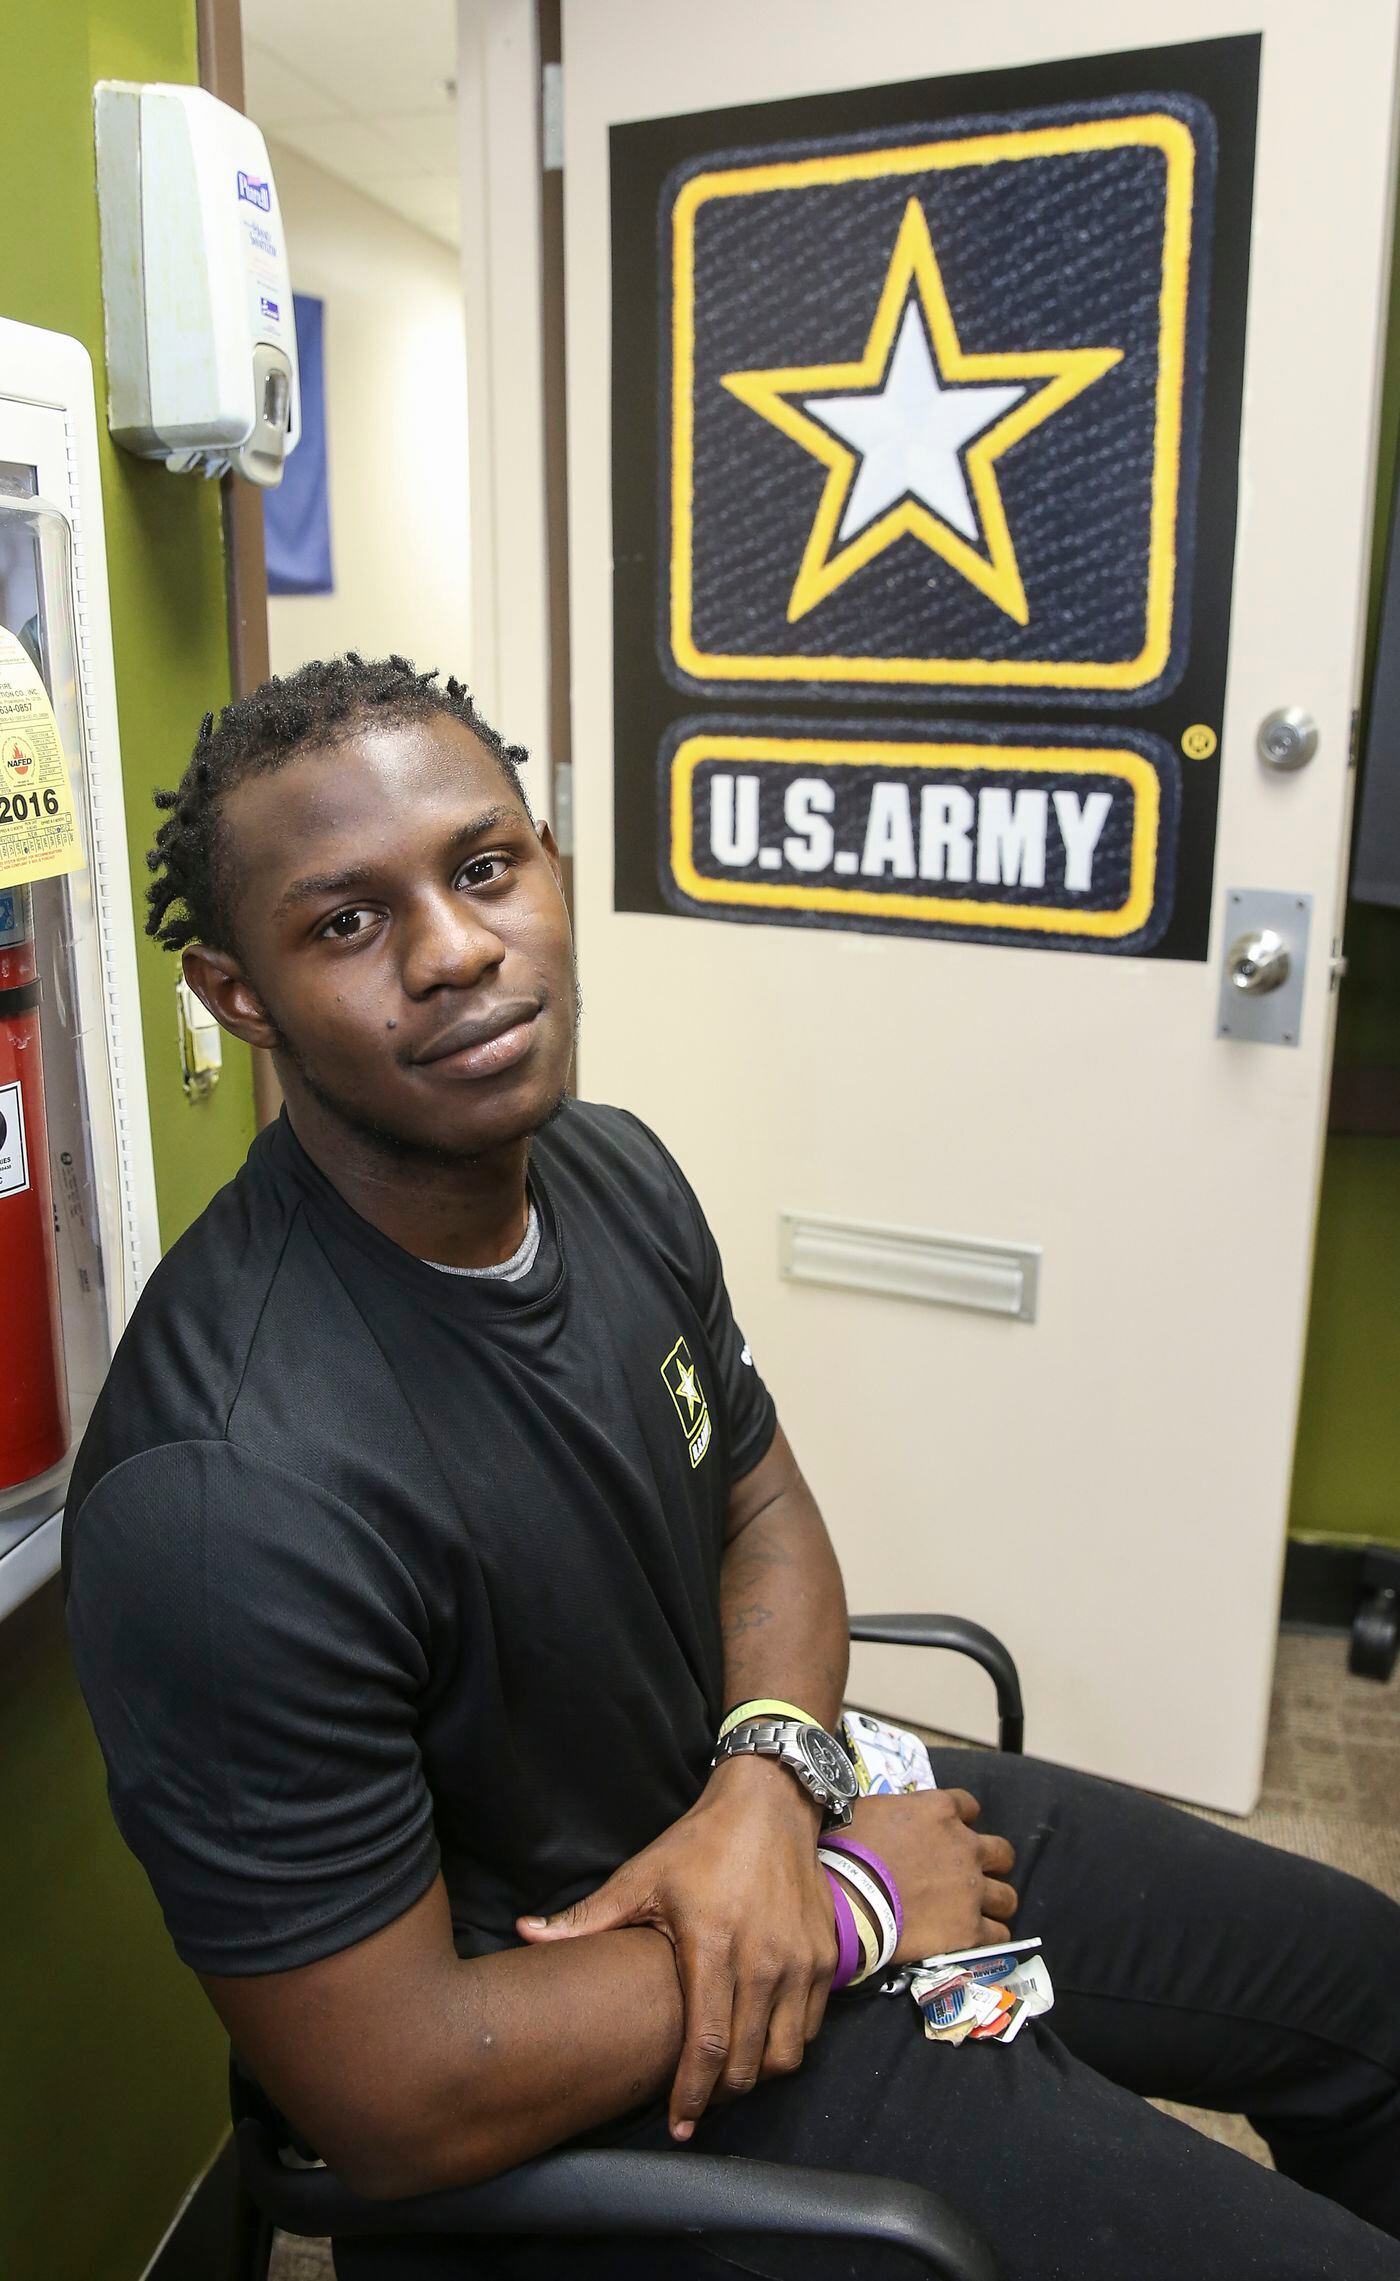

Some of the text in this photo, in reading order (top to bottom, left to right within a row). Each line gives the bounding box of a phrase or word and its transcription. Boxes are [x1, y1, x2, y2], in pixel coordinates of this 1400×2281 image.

[0, 702, 32, 714] 634-0857
[7, 757, 32, 768] NAFED
[0, 789, 59, 823] 2016
[709, 773, 1113, 892] U.S.ARMY
